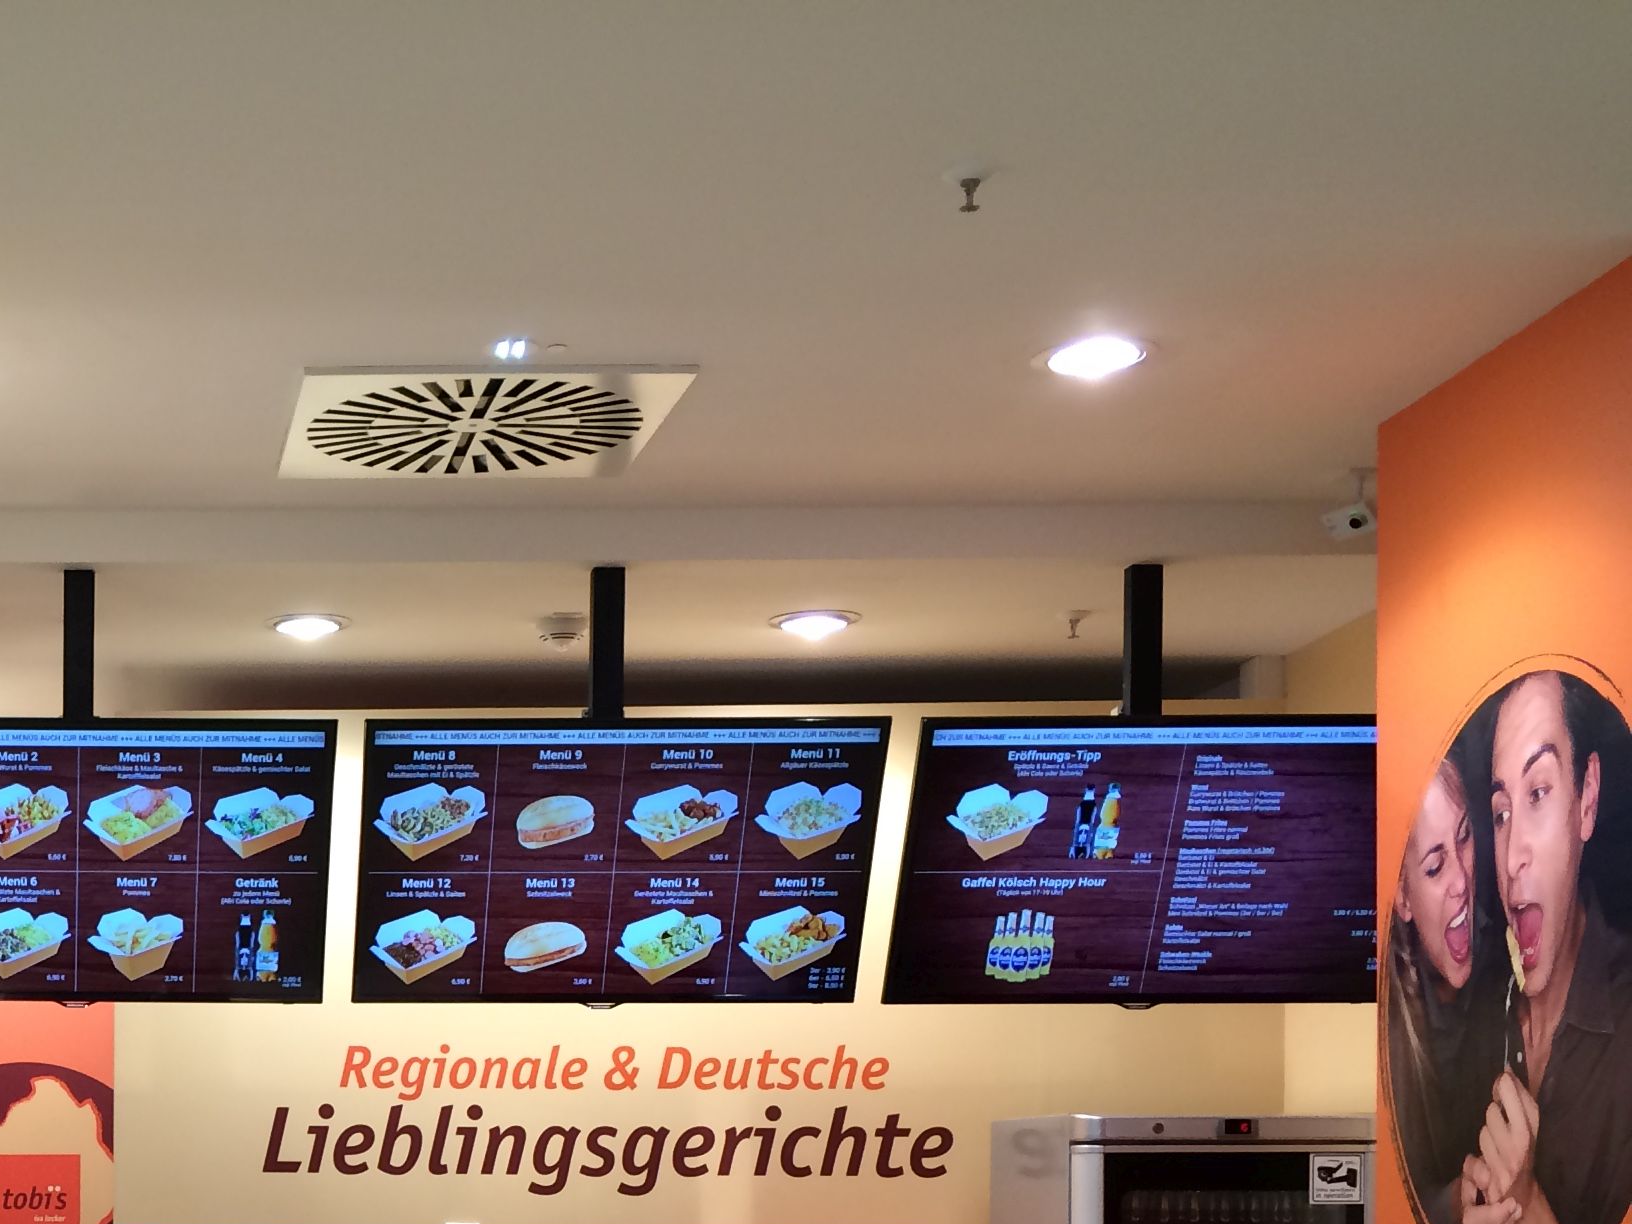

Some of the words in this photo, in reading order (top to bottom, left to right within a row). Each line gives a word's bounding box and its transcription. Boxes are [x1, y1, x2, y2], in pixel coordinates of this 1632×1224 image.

[31, 752, 38, 762] 2
[119, 753, 150, 762] Menü
[153, 753, 161, 762] 3
[241, 753, 272, 763] Menü
[275, 753, 283, 763] 4
[413, 751, 445, 761] Menü
[448, 751, 456, 761] 8
[540, 750, 571, 760] Menü
[575, 750, 582, 760] 9
[663, 749, 695, 759] Menü
[700, 749, 714, 759] 10
[790, 749, 823, 759] Menü
[828, 749, 840, 759] 11
[1008, 750, 1102, 763] Eröffnungs-Tipp
[30, 877, 37, 886] 6
[116, 877, 147, 887] Menü
[150, 877, 157, 887] 7
[235, 878, 278, 888] Getränk
[402, 878, 434, 888] Menü
[437, 878, 451, 888] 12
[526, 878, 557, 888] Menü
[561, 878, 575, 888] 13
[650, 878, 682, 888] Menü
[686, 878, 699, 888] 14
[775, 877, 807, 887] Menü
[811, 877, 825, 887] 15
[962, 877, 996, 888] Gaffel
[998, 876, 1037, 887] Kölsch
[1039, 877, 1076, 890] Happy
[1078, 877, 1107, 887] Hour
[340, 1045, 587, 1100] Regionale
[610, 1047, 641, 1091] &
[657, 1045, 889, 1091] Deutsche
[261, 1103, 954, 1197] Lieblingsgerichte
